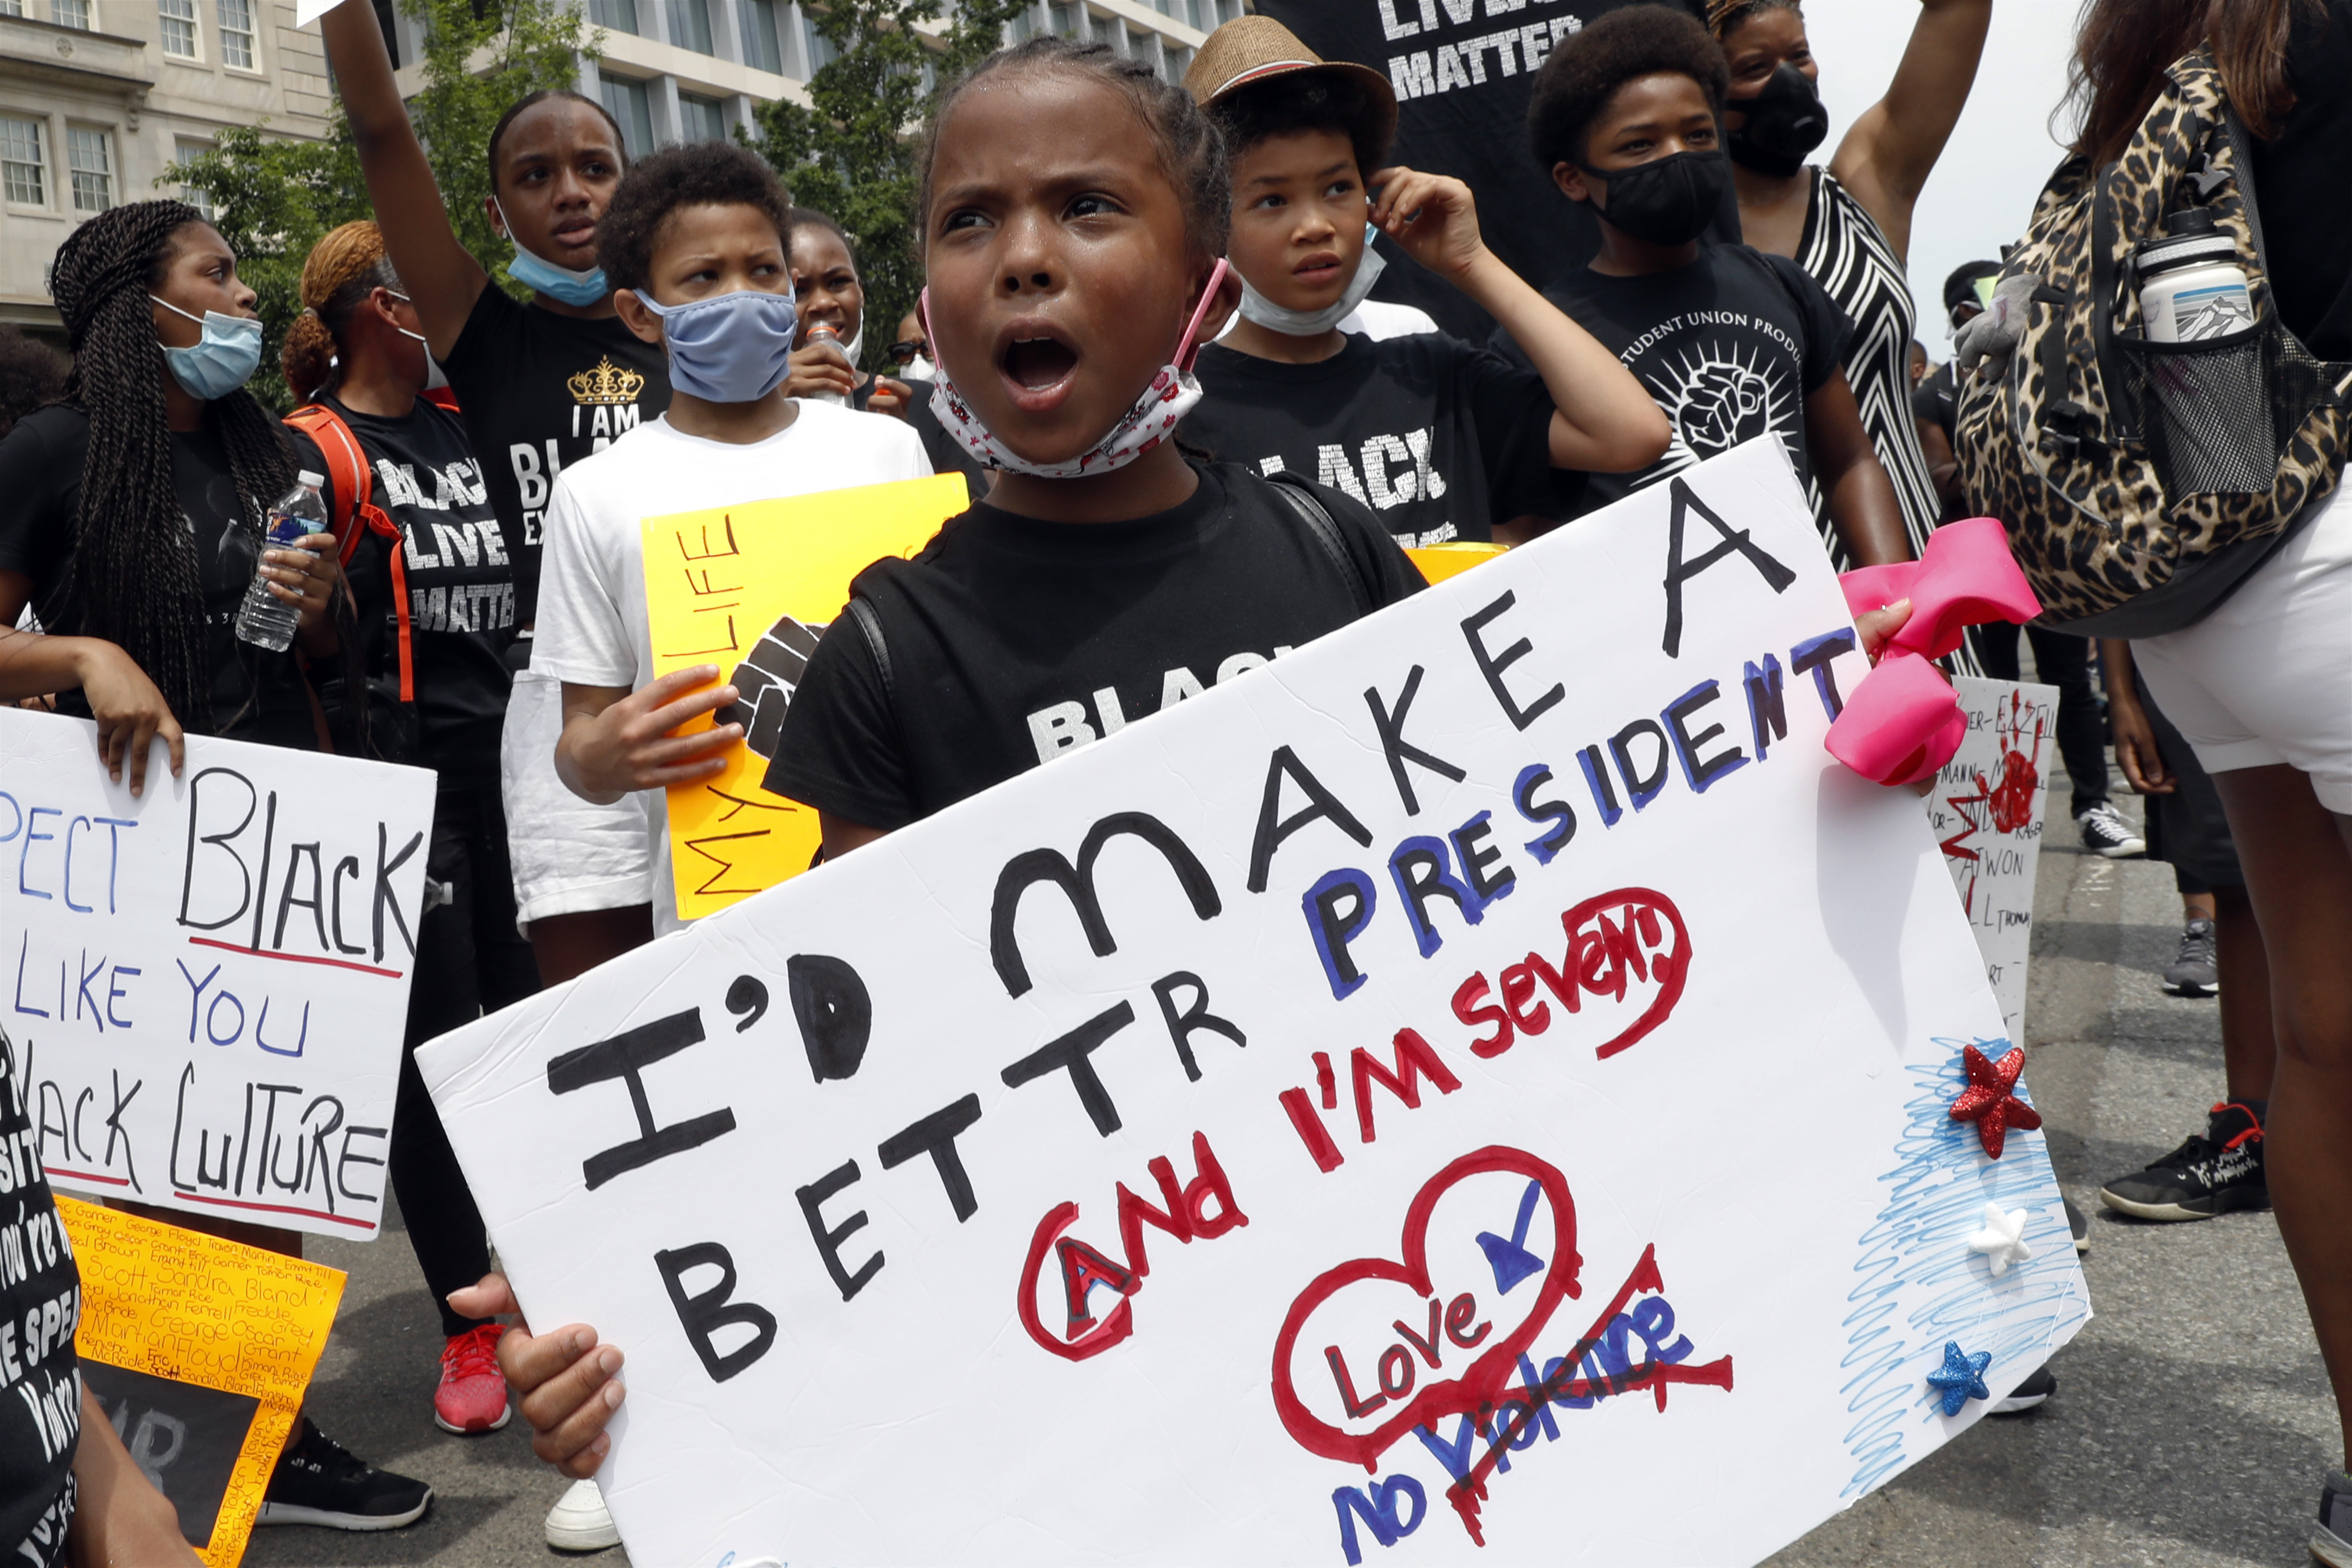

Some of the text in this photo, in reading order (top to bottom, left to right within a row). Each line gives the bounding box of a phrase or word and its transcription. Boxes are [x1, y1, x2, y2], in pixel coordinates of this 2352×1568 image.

[1687, 311, 1748, 326] UNION
[572, 403, 640, 437] I AM
[662, 514, 798, 895] MY LIFE
[990, 588, 1565, 1000] MAKE
[1661, 476, 1797, 658] A
[15, 928, 310, 1058] LIKE YOU
[654, 626, 1856, 1383] BETTR PRESIDENT
[94, 1238, 140, 1260] Brown
[126, 1219, 163, 1237] George
[169, 1228, 200, 1247] Floyd
[242, 1246, 275, 1265] Martin
[189, 1250, 211, 1264] Eric
[156, 1261, 235, 1296] Sandra
[245, 1277, 308, 1307] Bland
[189, 1289, 213, 1303] Rice
[150, 1307, 229, 1345] George
[232, 1320, 285, 1347] Oscar
[271, 1320, 314, 1348] Grey
[147, 1348, 170, 1366] Eric
[176, 1338, 241, 1376] Floyd
[244, 1342, 302, 1362] Grant
